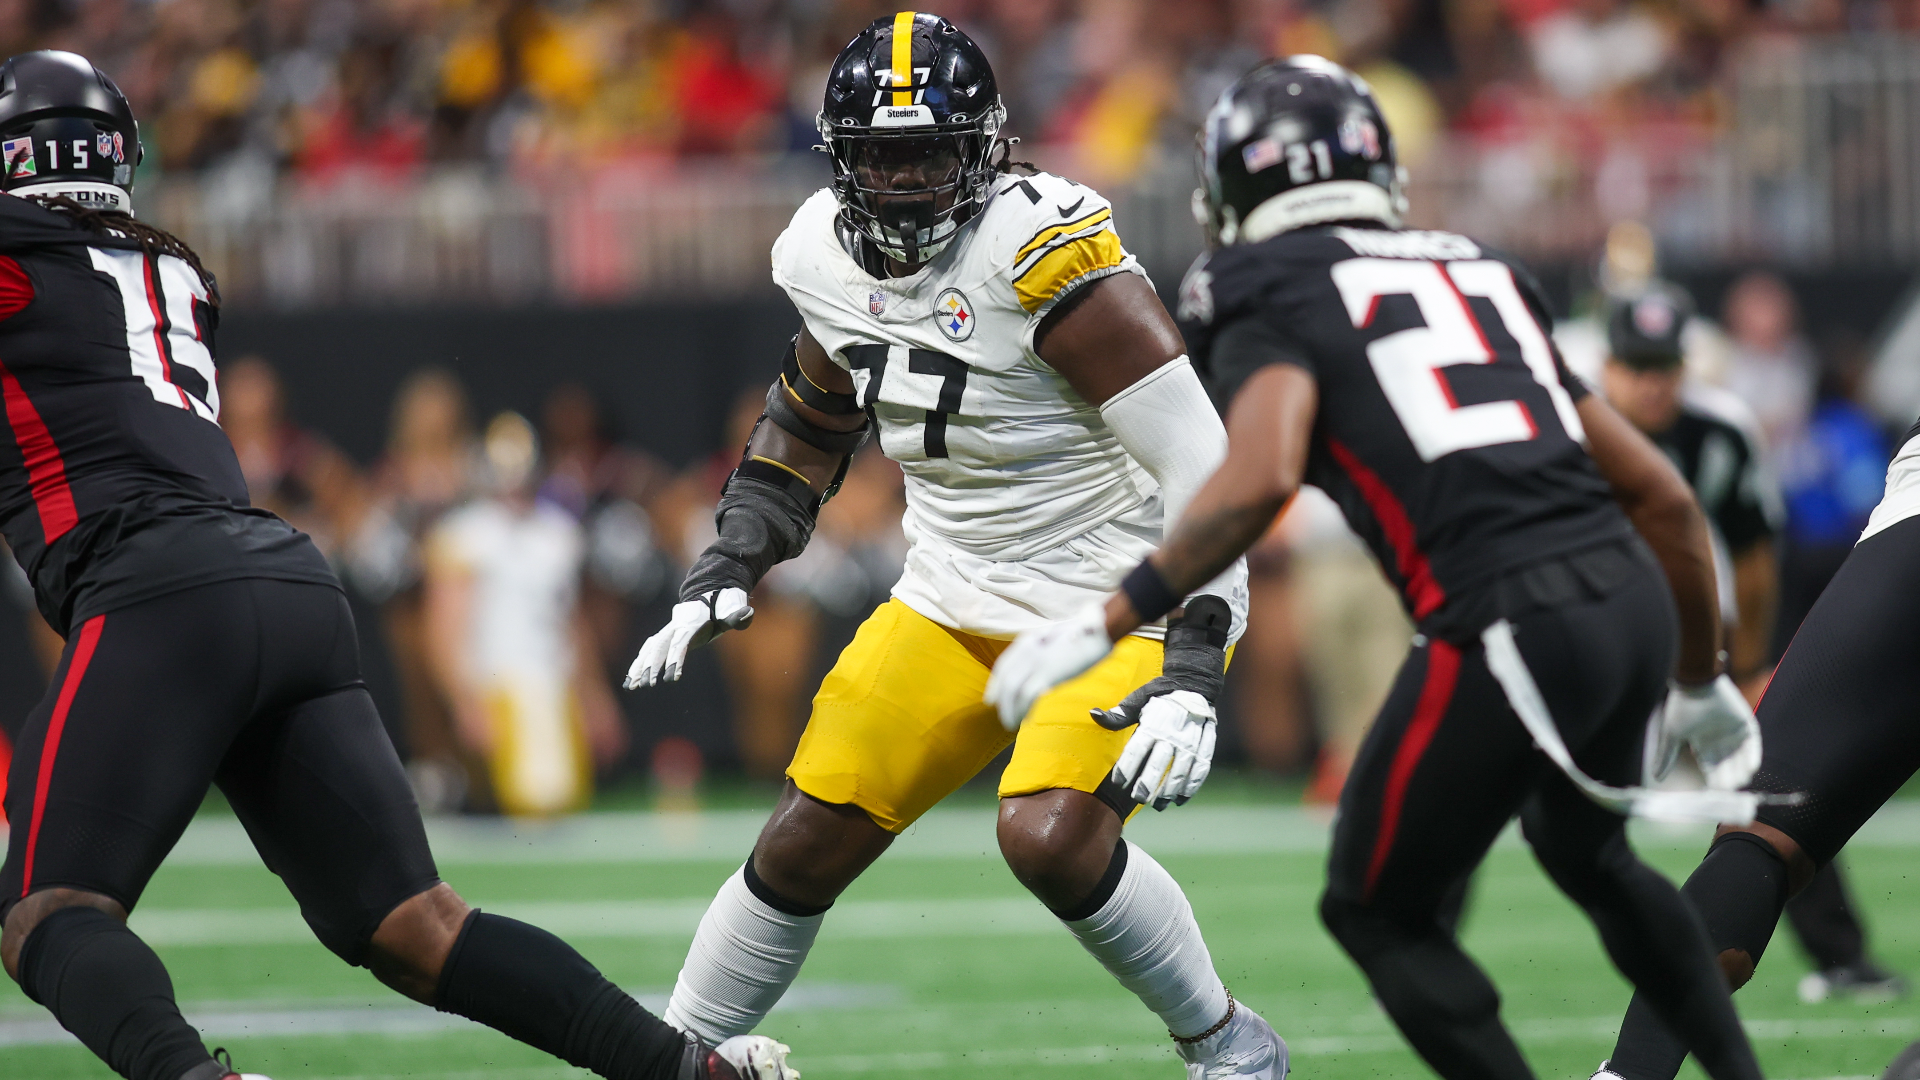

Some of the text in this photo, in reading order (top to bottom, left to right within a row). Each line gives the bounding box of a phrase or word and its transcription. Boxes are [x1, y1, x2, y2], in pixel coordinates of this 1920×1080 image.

[872, 67, 931, 107] 77
[887, 108, 919, 118] Steelers
[46, 140, 88, 170] 15
[99, 143, 111, 154] NFL
[1285, 141, 1333, 184] 21
[86, 246, 222, 430] 15
[1330, 257, 1588, 464] 21
[840, 343, 970, 458] 77
